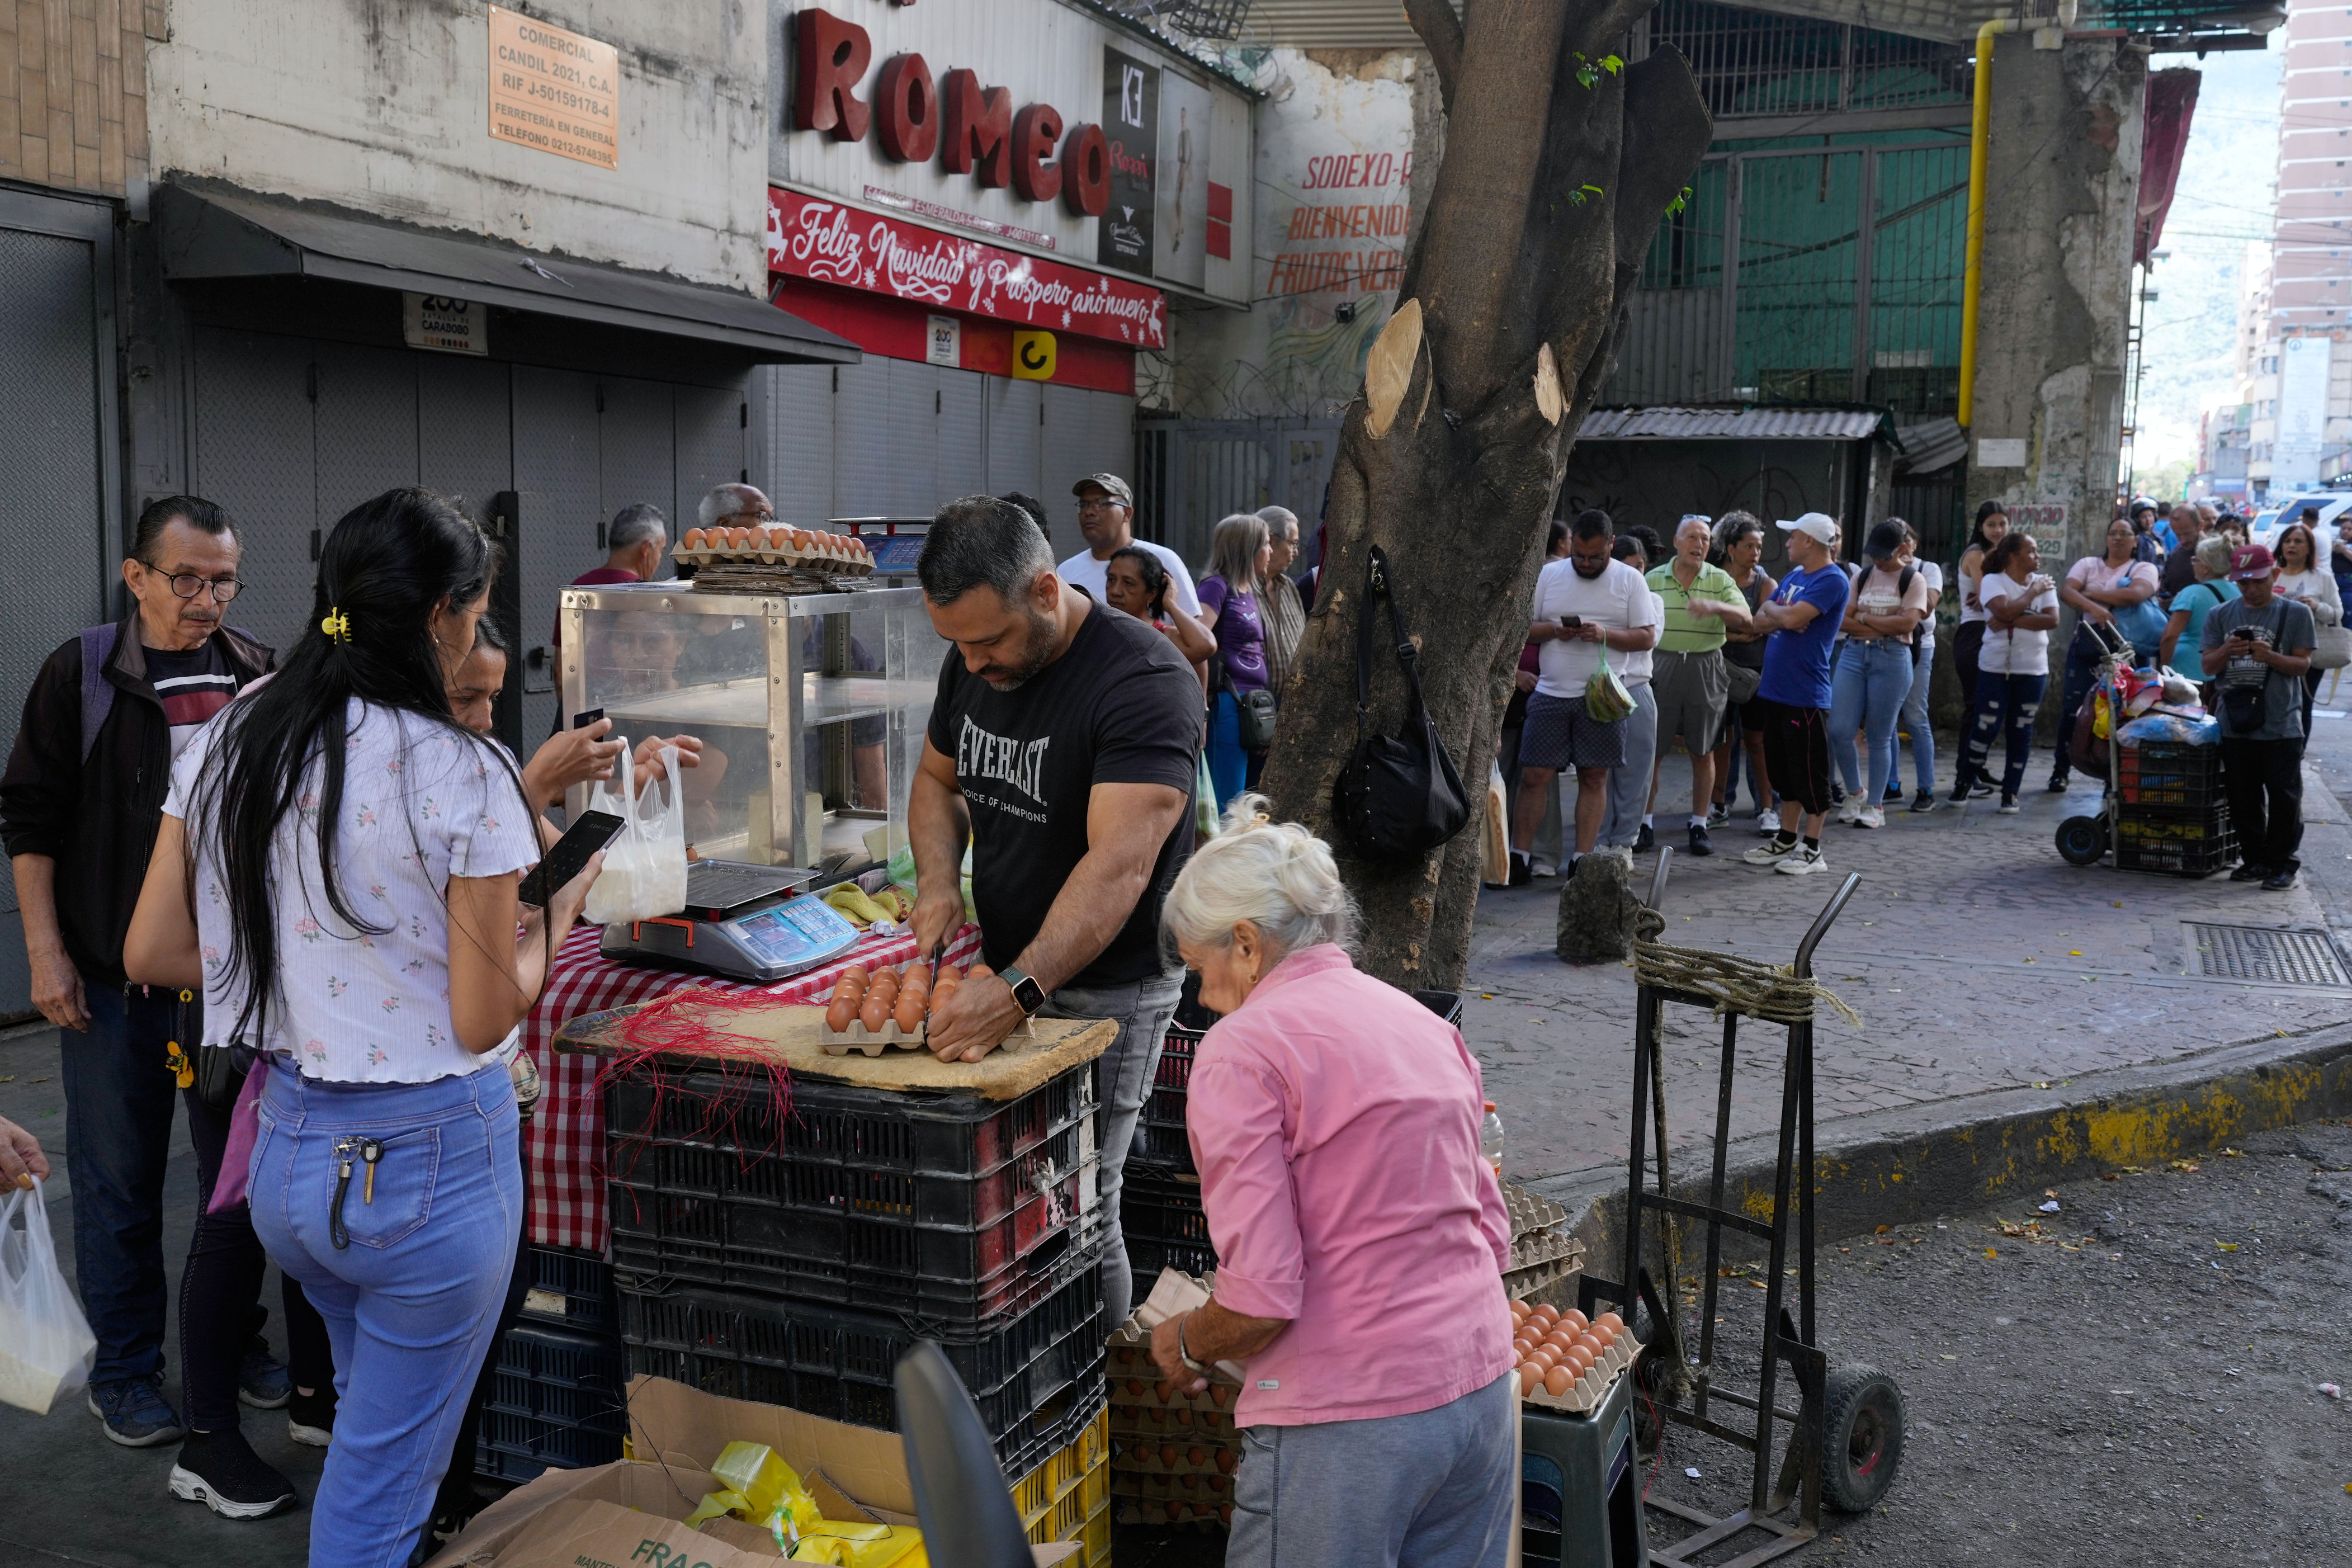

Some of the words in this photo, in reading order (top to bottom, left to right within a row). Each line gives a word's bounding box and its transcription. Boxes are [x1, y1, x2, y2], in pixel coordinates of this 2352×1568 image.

[519, 26, 594, 63] COMERCIAL
[499, 45, 548, 73] CANDIL
[552, 63, 585, 88] 2021,
[589, 75, 612, 94] C.A.
[503, 73, 523, 91] RIF
[528, 82, 609, 118] J-50159178-4
[796, 8, 1110, 216] ROMEO
[495, 102, 555, 129] FERRETERÍA
[558, 121, 570, 133] EN
[573, 126, 615, 147] GENERAL
[498, 123, 549, 146] TELÉFONO
[552, 138, 612, 164] 0212-5748395
[915, 201, 965, 224] ESMERALDA
[793, 202, 863, 284] Feliz
[869, 221, 965, 301] Navidad
[969, 266, 985, 310] y
[988, 259, 1072, 320] Prospero
[1072, 286, 1105, 314] año
[1105, 295, 1149, 324] nuevo
[422, 320, 469, 335] CARABOBO
[2037, 540, 2061, 554] 529
[957, 714, 1050, 804] EVERLAST
[959, 784, 985, 803] HOICE
[989, 797, 999, 807] OF
[1000, 801, 1047, 823] CHAMPIONS
[574, 1555, 620, 1568] MANT
[630, 1539, 722, 1568] FRA
